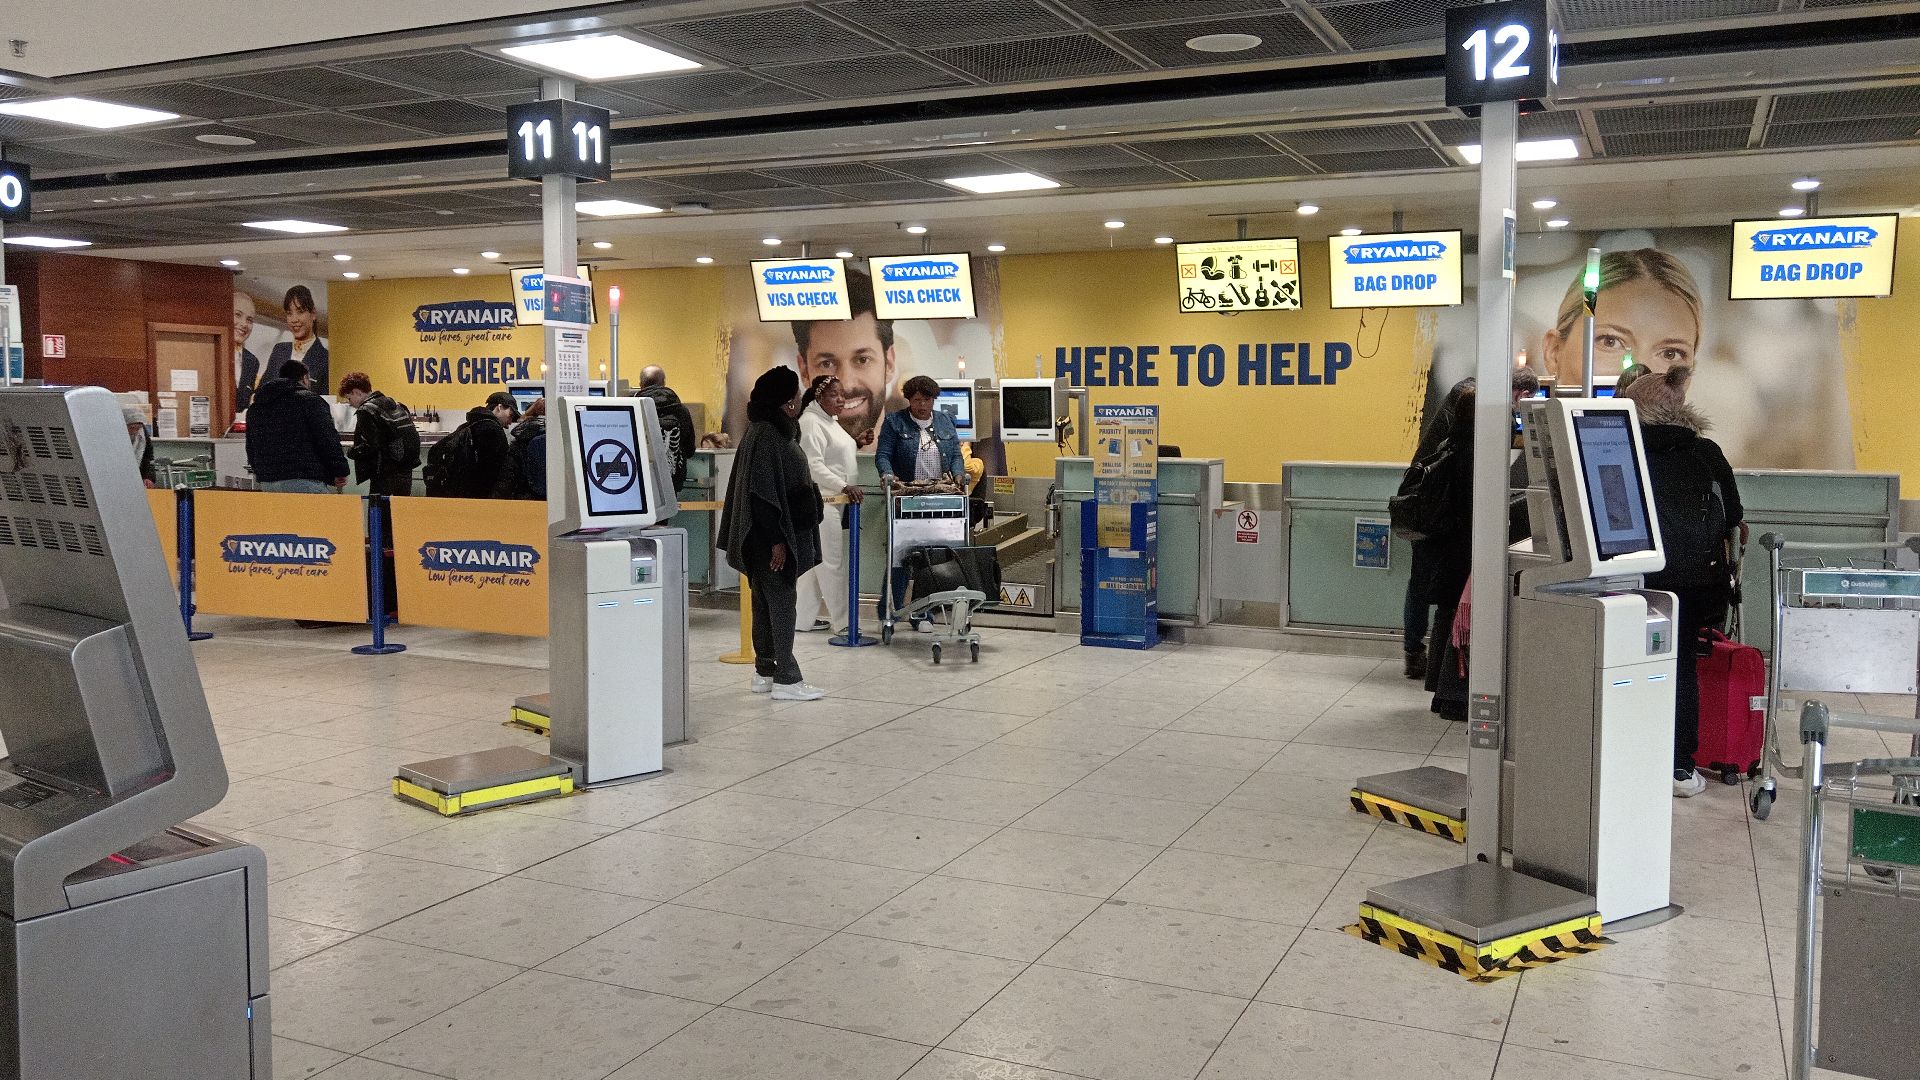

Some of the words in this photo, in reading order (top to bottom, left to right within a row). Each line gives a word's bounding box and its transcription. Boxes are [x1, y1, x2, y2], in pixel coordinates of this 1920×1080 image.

[1462, 24, 1530, 80] 12
[518, 119, 552, 160] 11
[572, 121, 601, 164] 11
[1771, 231, 1870, 246] RYANAIR
[1361, 244, 1440, 259] RYANAIR
[774, 270, 831, 280] RYANAIR
[894, 265, 954, 277] RYANAIR
[1760, 264, 1800, 281] BAG
[1806, 262, 1863, 280] DROP
[1354, 275, 1386, 291] BAG
[1391, 273, 1437, 290] DROP
[523, 298, 543, 311] VIS
[767, 292, 795, 306] VISA
[797, 291, 838, 306] CHECK
[885, 289, 915, 304] VISA
[917, 288, 961, 303] CHECK
[430, 308, 514, 325] RYANAIR
[420, 331, 437, 342] Low
[439, 330, 463, 345] fares,
[464, 330, 490, 346] great
[492, 333, 512, 341] care
[404, 357, 452, 384] VISA
[457, 356, 530, 384] CHECK
[1055, 345, 1159, 387] HERE
[1170, 343, 1226, 387] TO
[1238, 342, 1352, 385] HELP
[1105, 408, 1154, 416] RYANAIR
[240, 541, 329, 559] RYANAIR
[440, 548, 533, 568] RYANAIR
[228, 561, 246, 573] Low
[249, 560, 274, 577] fares,
[276, 565, 304, 580] great
[306, 568, 328, 577] care
[428, 570, 445, 581] Low
[449, 568, 476, 586] fares,
[477, 573, 507, 589] great
[509, 577, 530, 586] care
